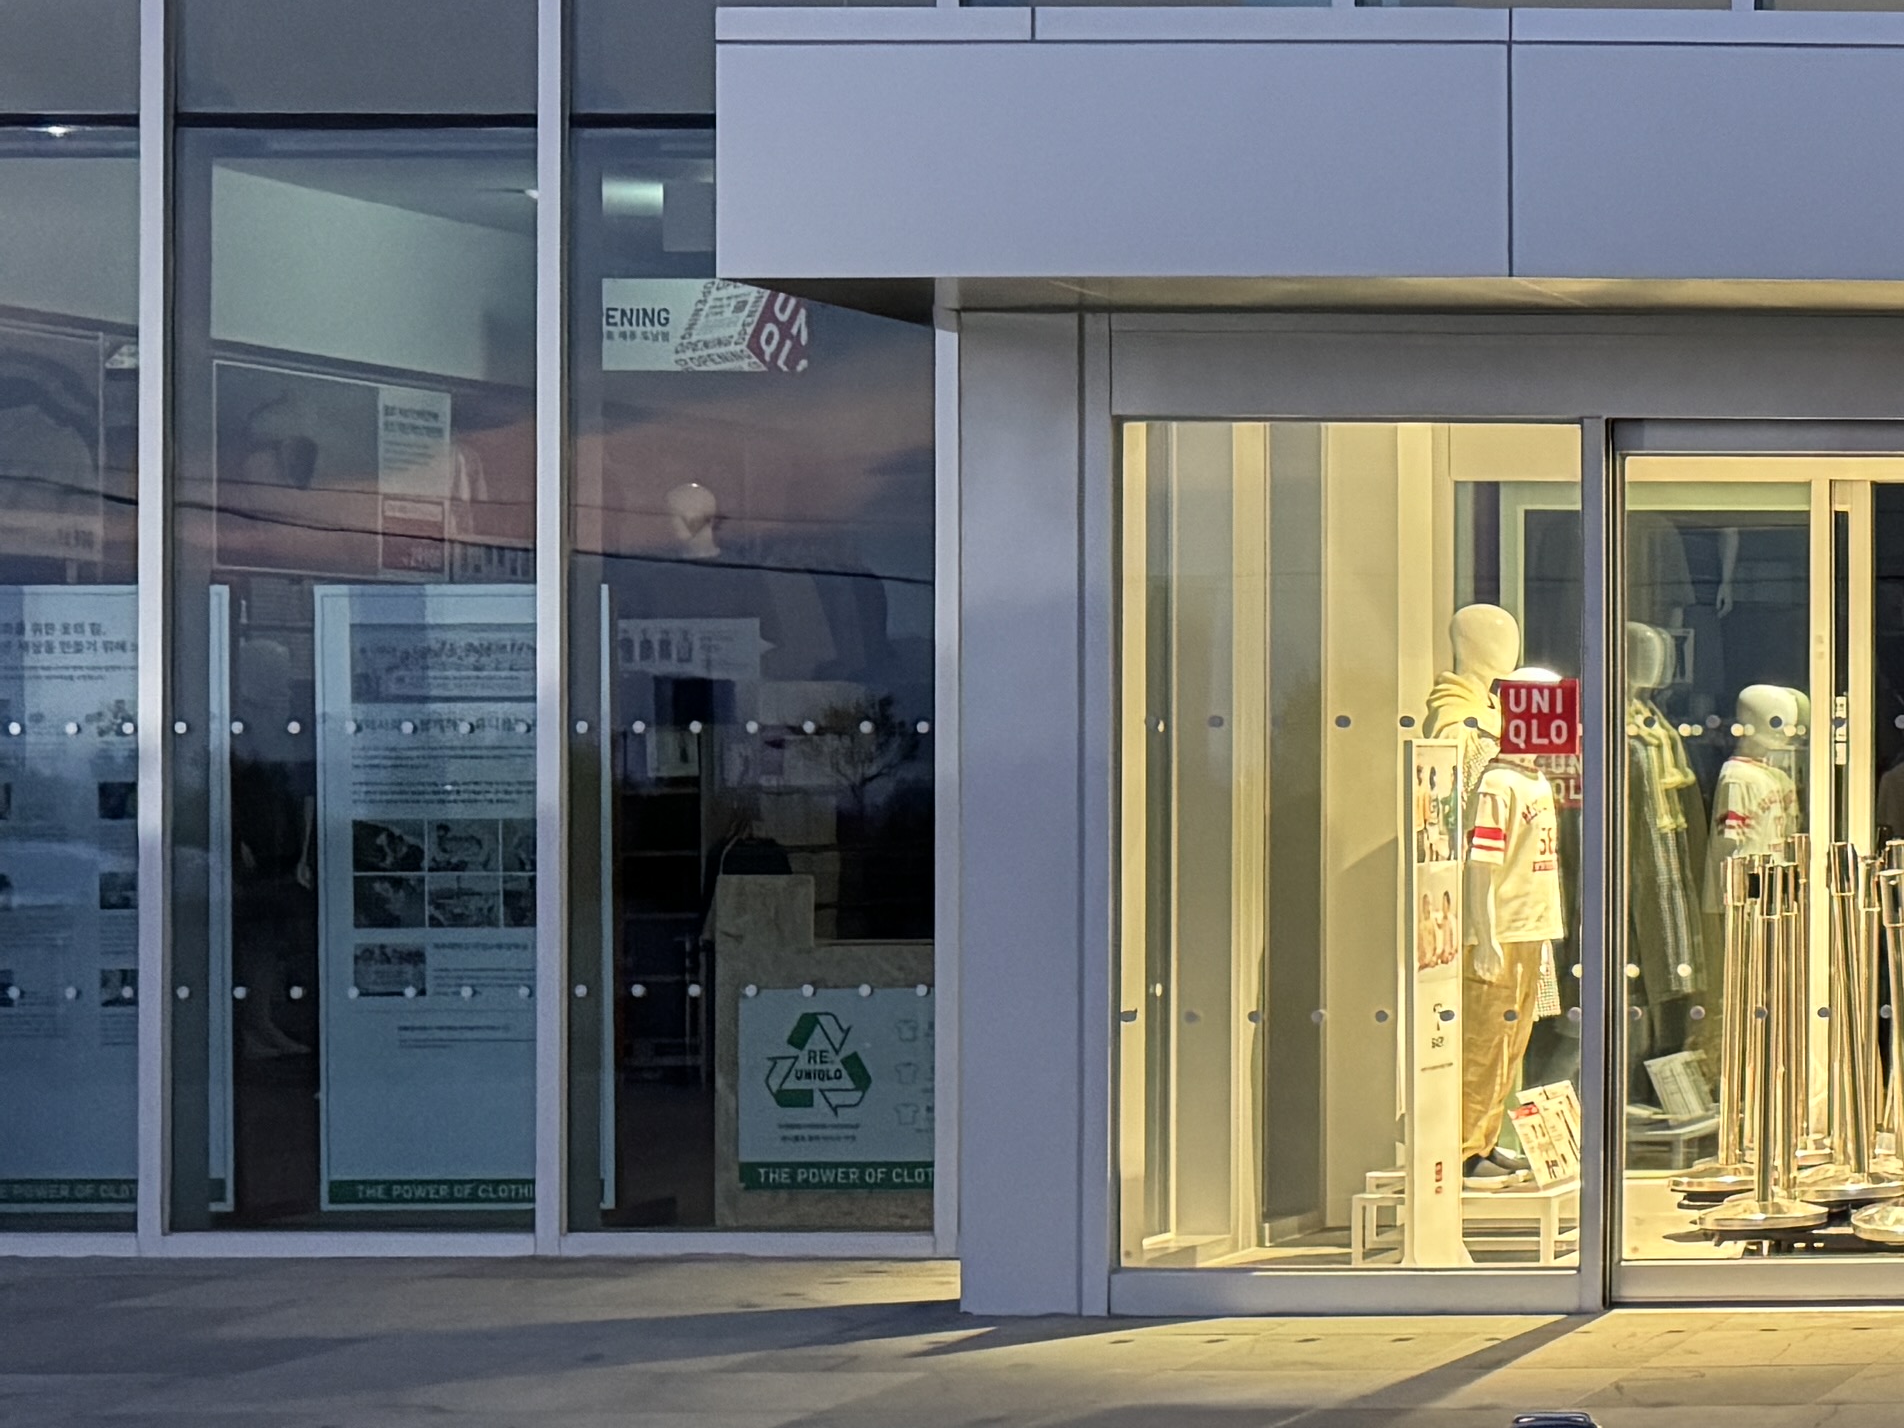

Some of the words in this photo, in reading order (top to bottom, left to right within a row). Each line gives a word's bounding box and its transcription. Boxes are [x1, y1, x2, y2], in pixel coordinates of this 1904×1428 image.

[605, 307, 671, 328] ENING
[1508, 687, 1564, 714] UNI
[1508, 719, 1568, 749] QLO
[795, 1068, 843, 1082] UNIQLO
[757, 1168, 791, 1184] THE
[797, 1168, 860, 1184] POWER
[865, 1168, 887, 1184] OF
[13, 1184, 70, 1199] POWER
[74, 1184, 96, 1199] OF
[357, 1184, 389, 1199] THE
[392, 1184, 450, 1199] POWER
[453, 1184, 475, 1199] OF
